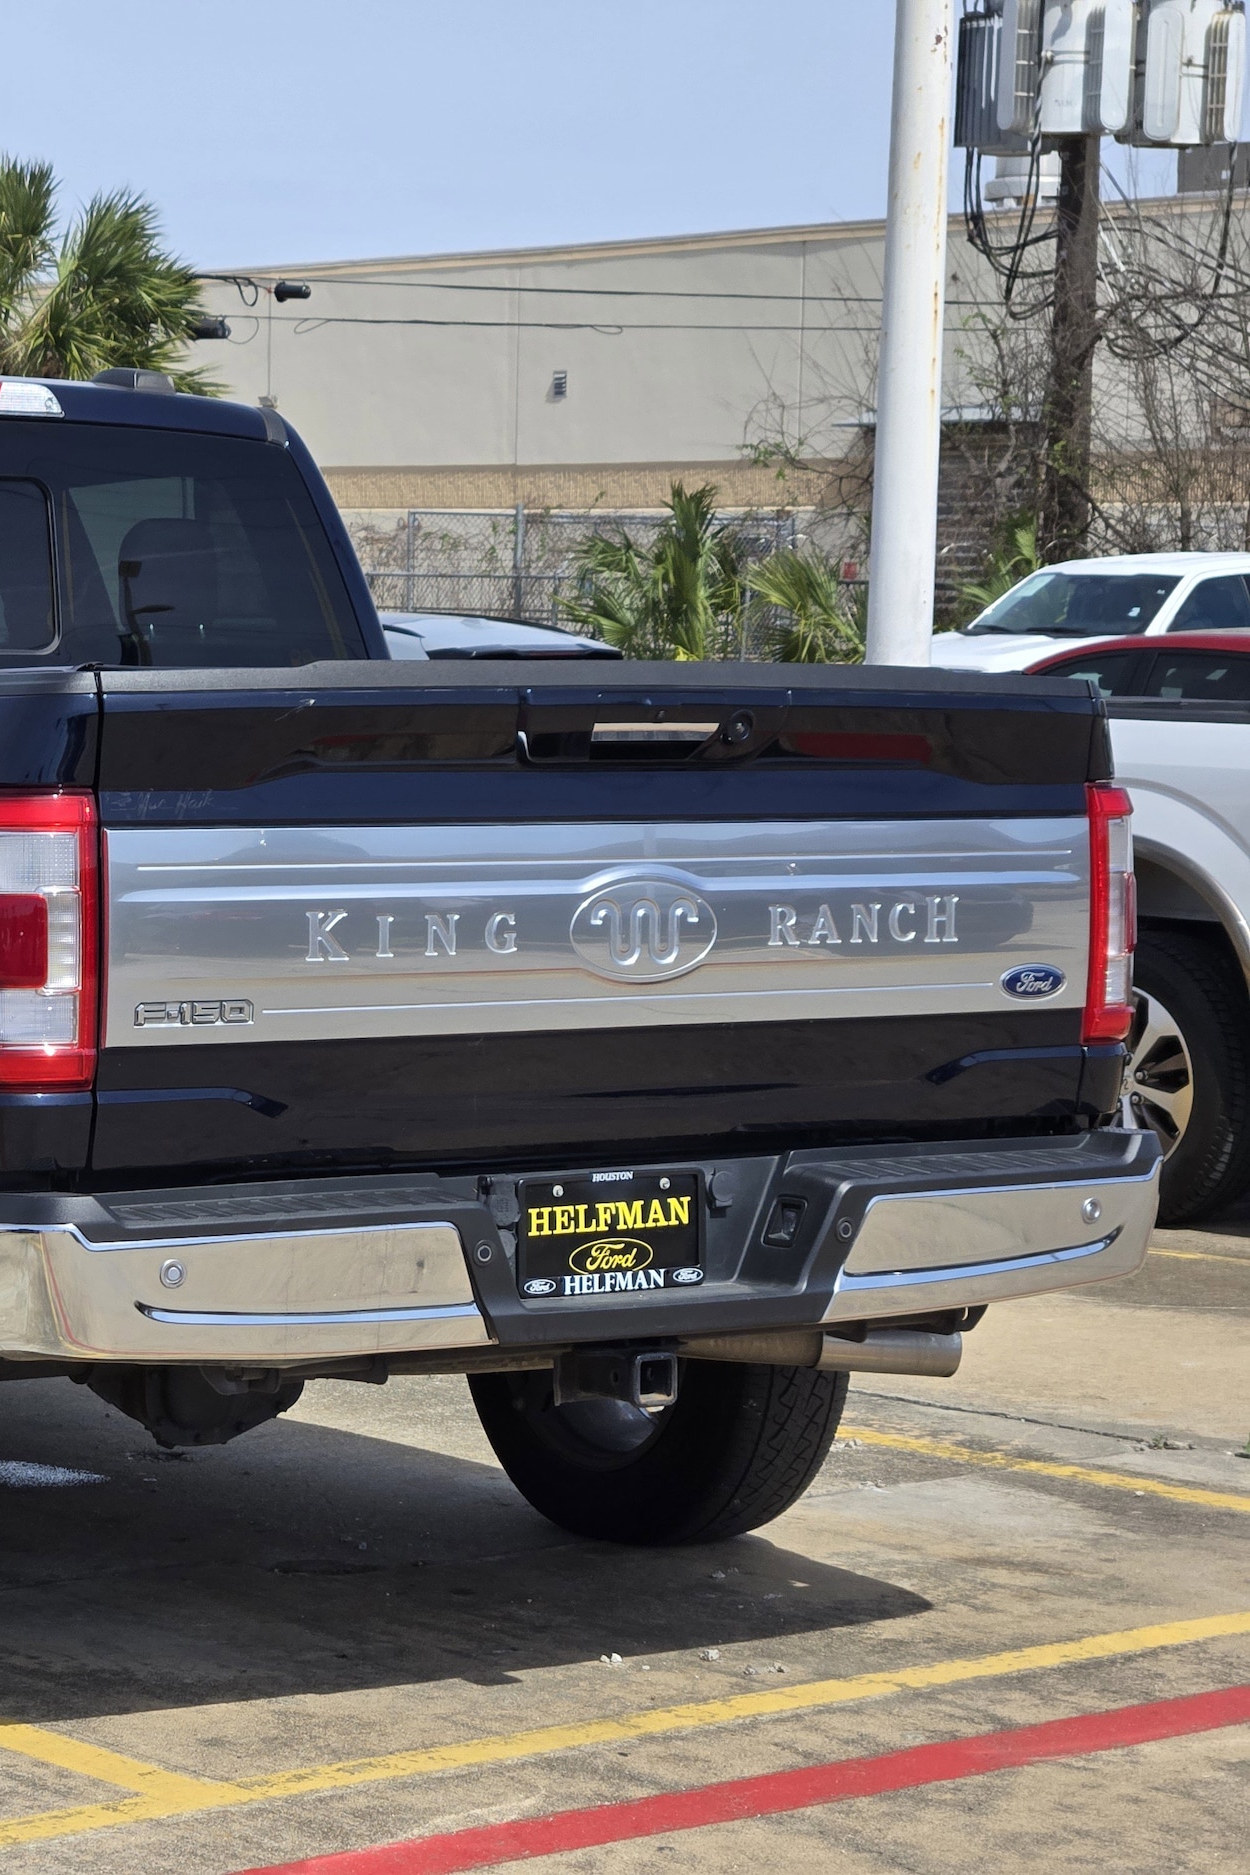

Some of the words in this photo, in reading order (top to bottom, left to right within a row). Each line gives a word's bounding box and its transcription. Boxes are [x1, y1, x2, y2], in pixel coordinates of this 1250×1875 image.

[305, 909, 518, 961] KING
[768, 895, 960, 945] RANCH
[1016, 971, 1054, 992] Ford
[134, 999, 255, 1028] F-150
[592, 1171, 634, 1183] HOUSTON
[527, 1196, 691, 1237] HELFMAN
[586, 1243, 638, 1271] Ford
[563, 1268, 666, 1295] HELFMAN
